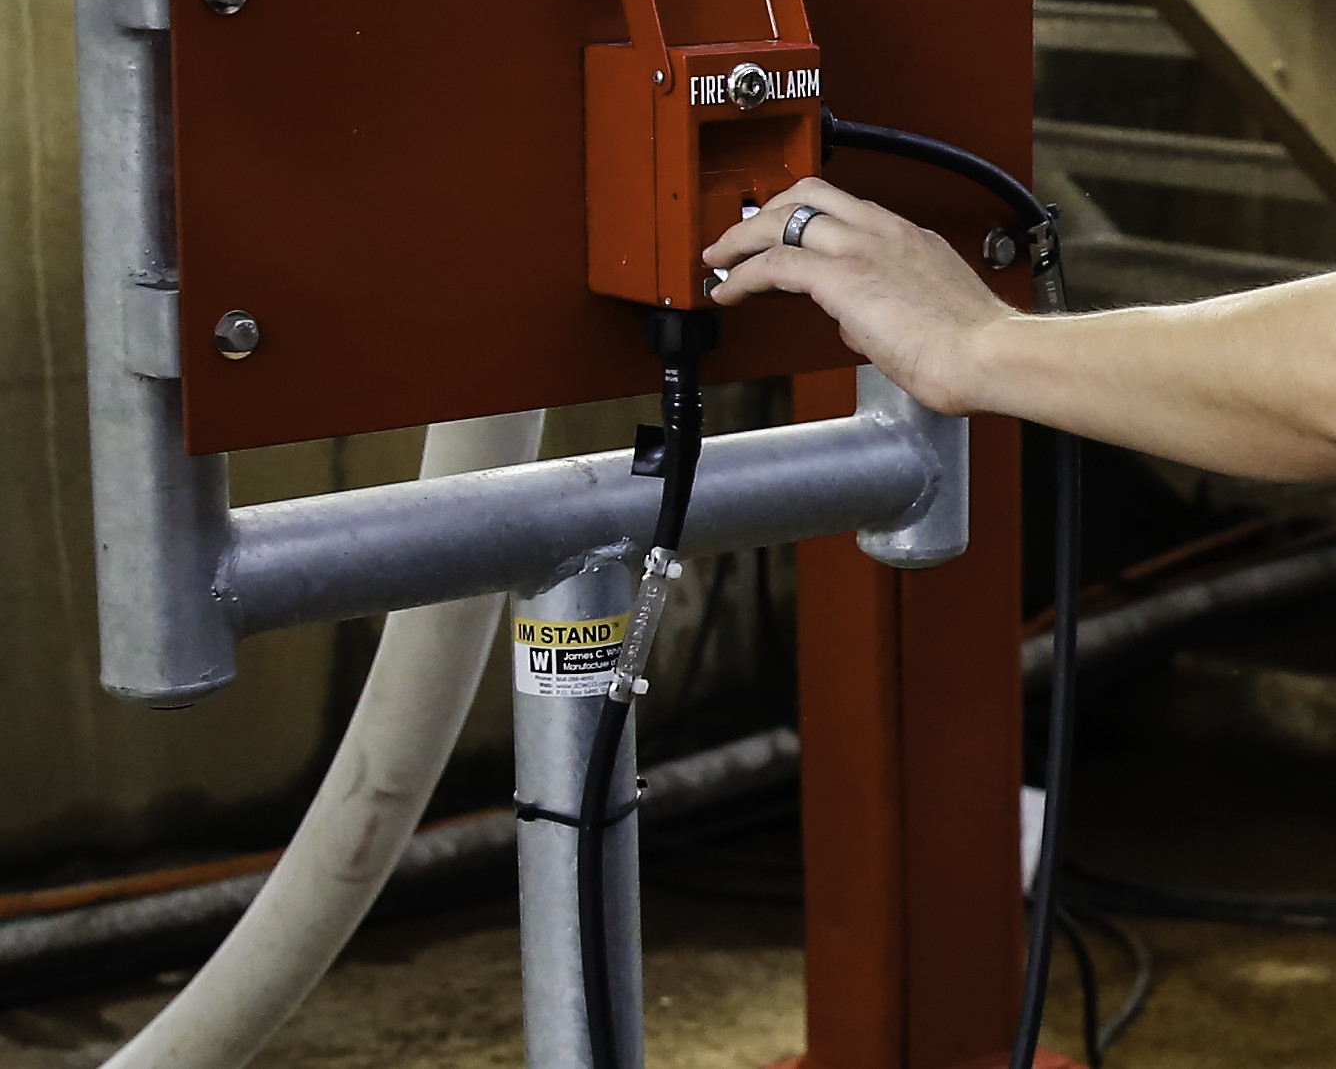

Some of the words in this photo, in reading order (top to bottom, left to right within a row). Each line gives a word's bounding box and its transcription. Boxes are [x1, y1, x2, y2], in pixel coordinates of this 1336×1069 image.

[691, 75, 726, 105] FIRE
[765, 69, 820, 100] ALARM
[518, 623, 535, 642] IM
[541, 624, 611, 644] STAND
[532, 650, 550, 671] W
[563, 652, 594, 661] James
[563, 661, 609, 671] Manufacturer
